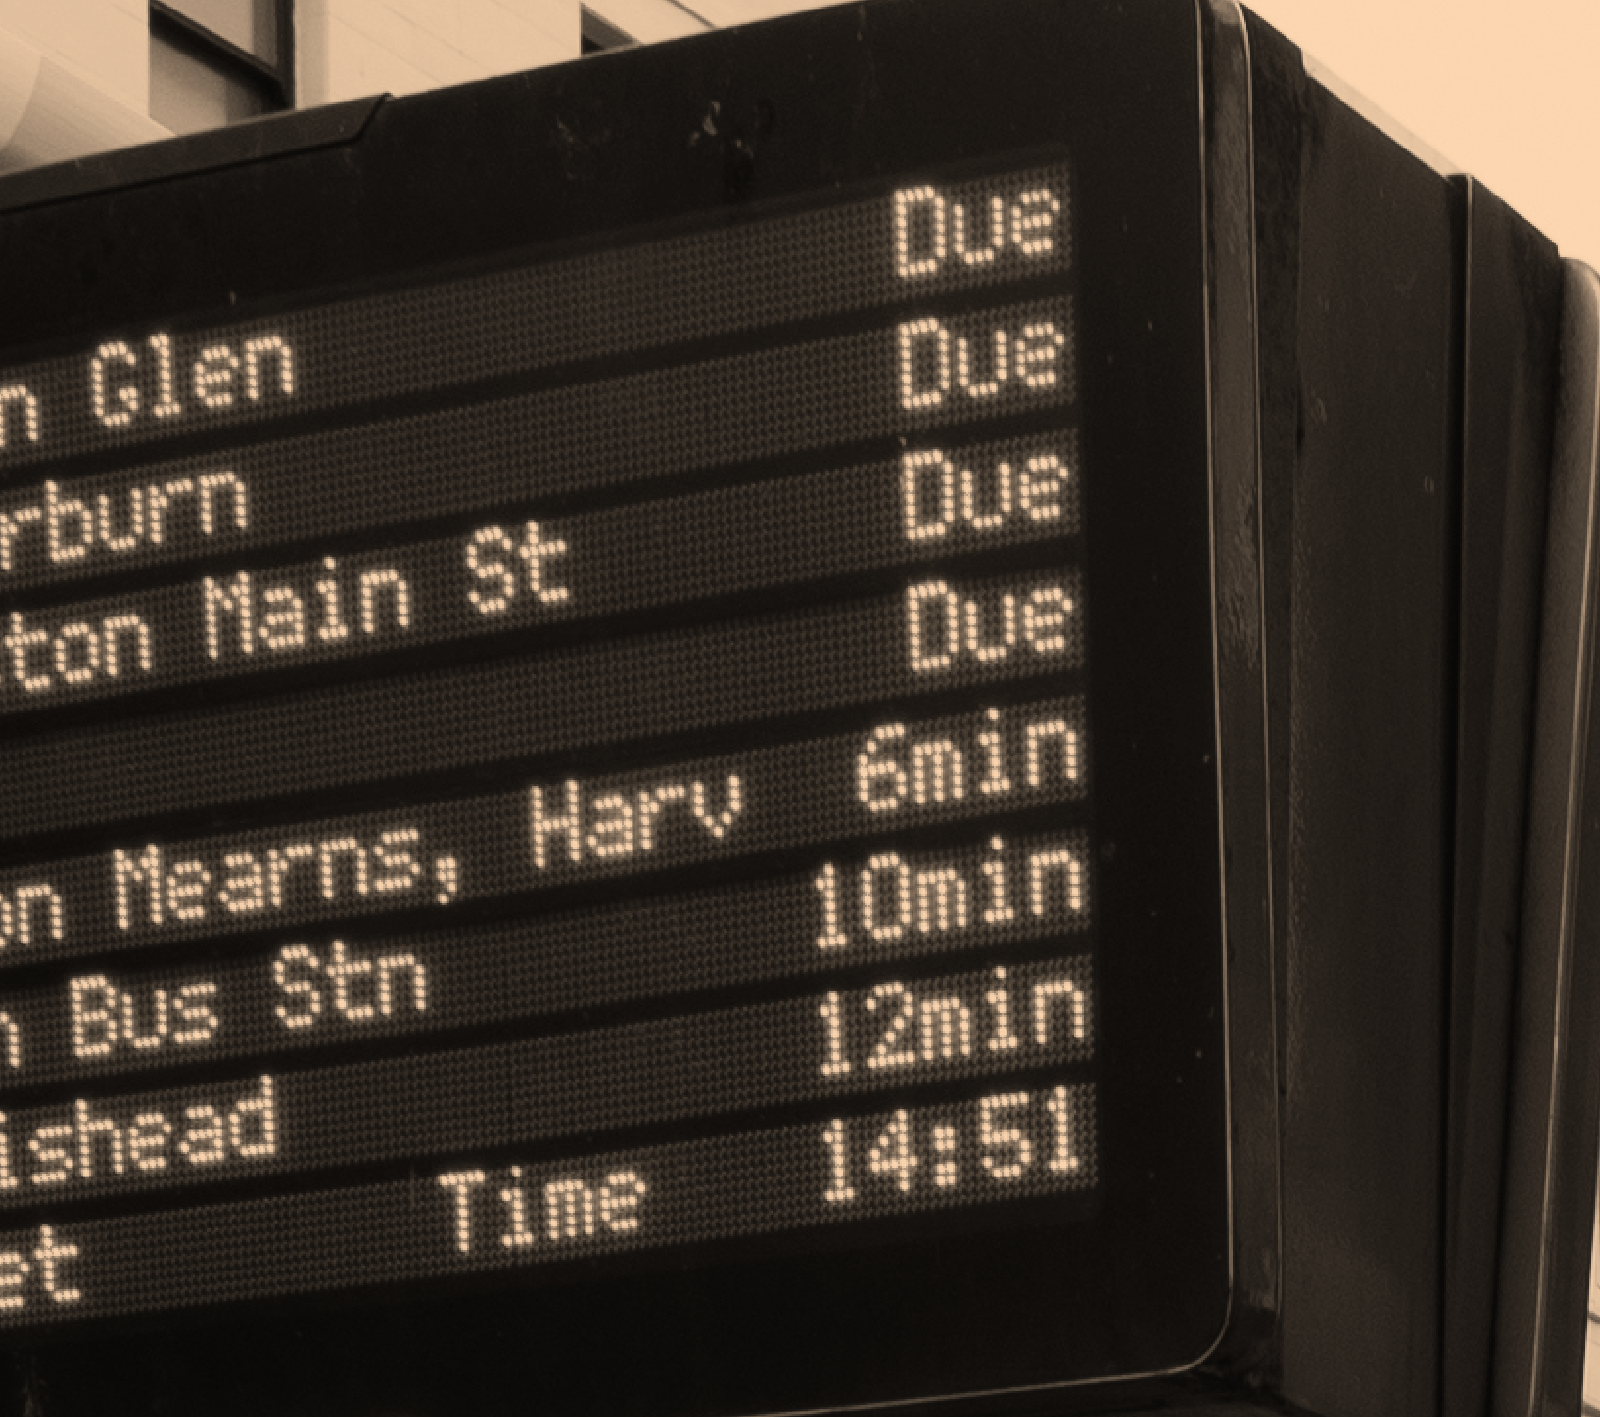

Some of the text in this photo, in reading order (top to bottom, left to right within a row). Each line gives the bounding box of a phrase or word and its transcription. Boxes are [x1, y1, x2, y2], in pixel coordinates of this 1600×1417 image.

[88, 330, 297, 430] Glen
[890, 182, 1063, 282] Due
[895, 314, 1068, 413] Due
[200, 554, 413, 662] Main
[463, 518, 572, 617] St
[897, 446, 1072, 544] Due
[904, 577, 1077, 675] Due
[111, 825, 460, 933] Mearns,
[528, 772, 745, 871] Harv
[853, 705, 1081, 816] 6min
[67, 972, 222, 1061] Bus
[270, 938, 430, 1032] Stn
[812, 834, 1085, 952] 10min
[816, 963, 1088, 1079] 12min
[435, 1163, 650, 1255] Time
[819, 1083, 1082, 1205] 14:51
